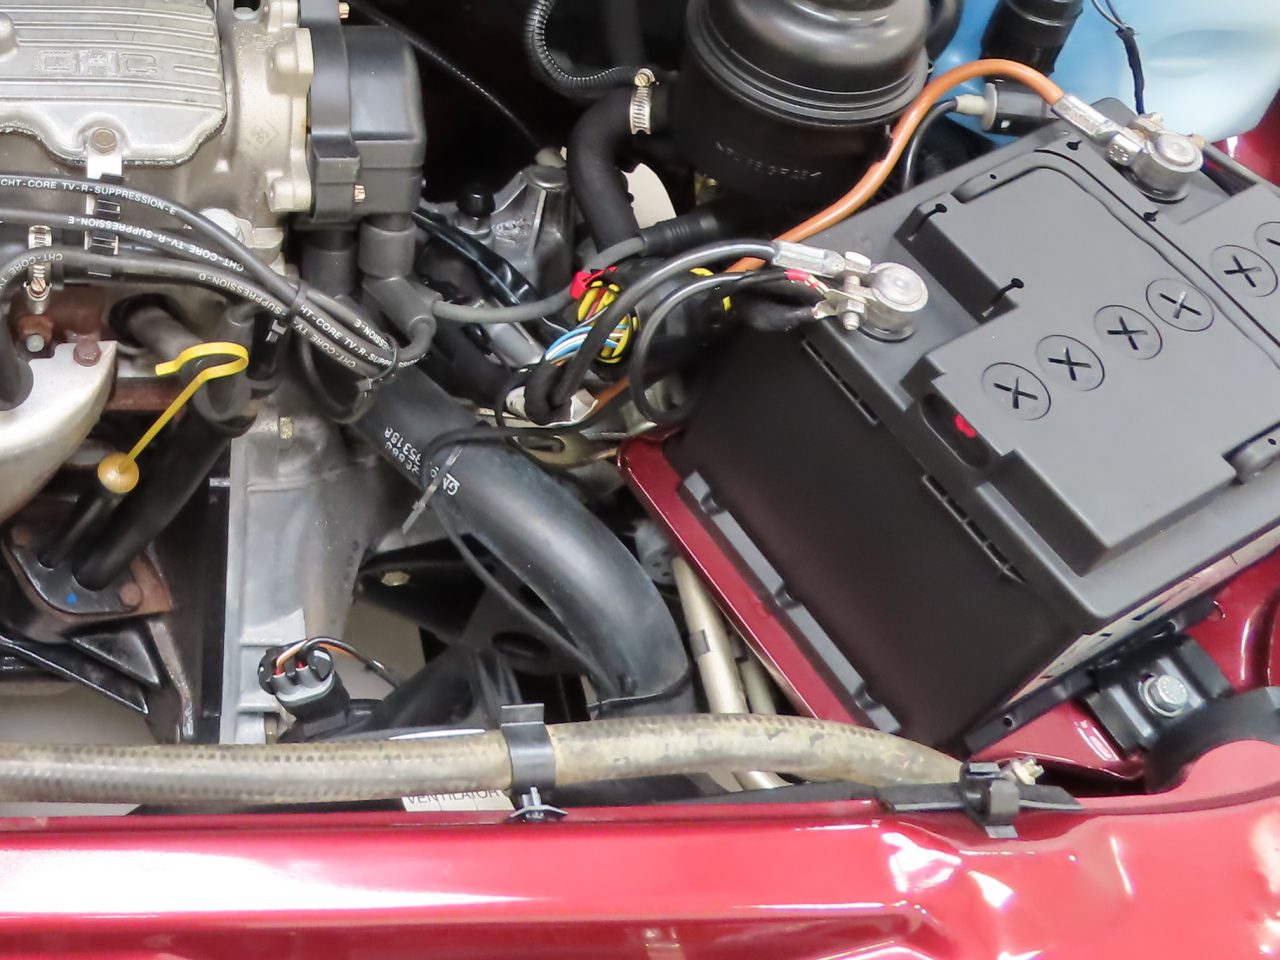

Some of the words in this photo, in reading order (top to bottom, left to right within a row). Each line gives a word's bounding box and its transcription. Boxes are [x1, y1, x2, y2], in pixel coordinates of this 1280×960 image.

[0, 178, 58, 189] CHT-CORE
[62, 181, 177, 216] TV-R-SUPPRESSION-E
[67, 215, 189, 251] TV-R-SUPPRESSION-E
[8, 252, 63, 276] CHT-CORE
[189, 244, 245, 273] CHT-CORE
[299, 304, 344, 340] HT-CORE
